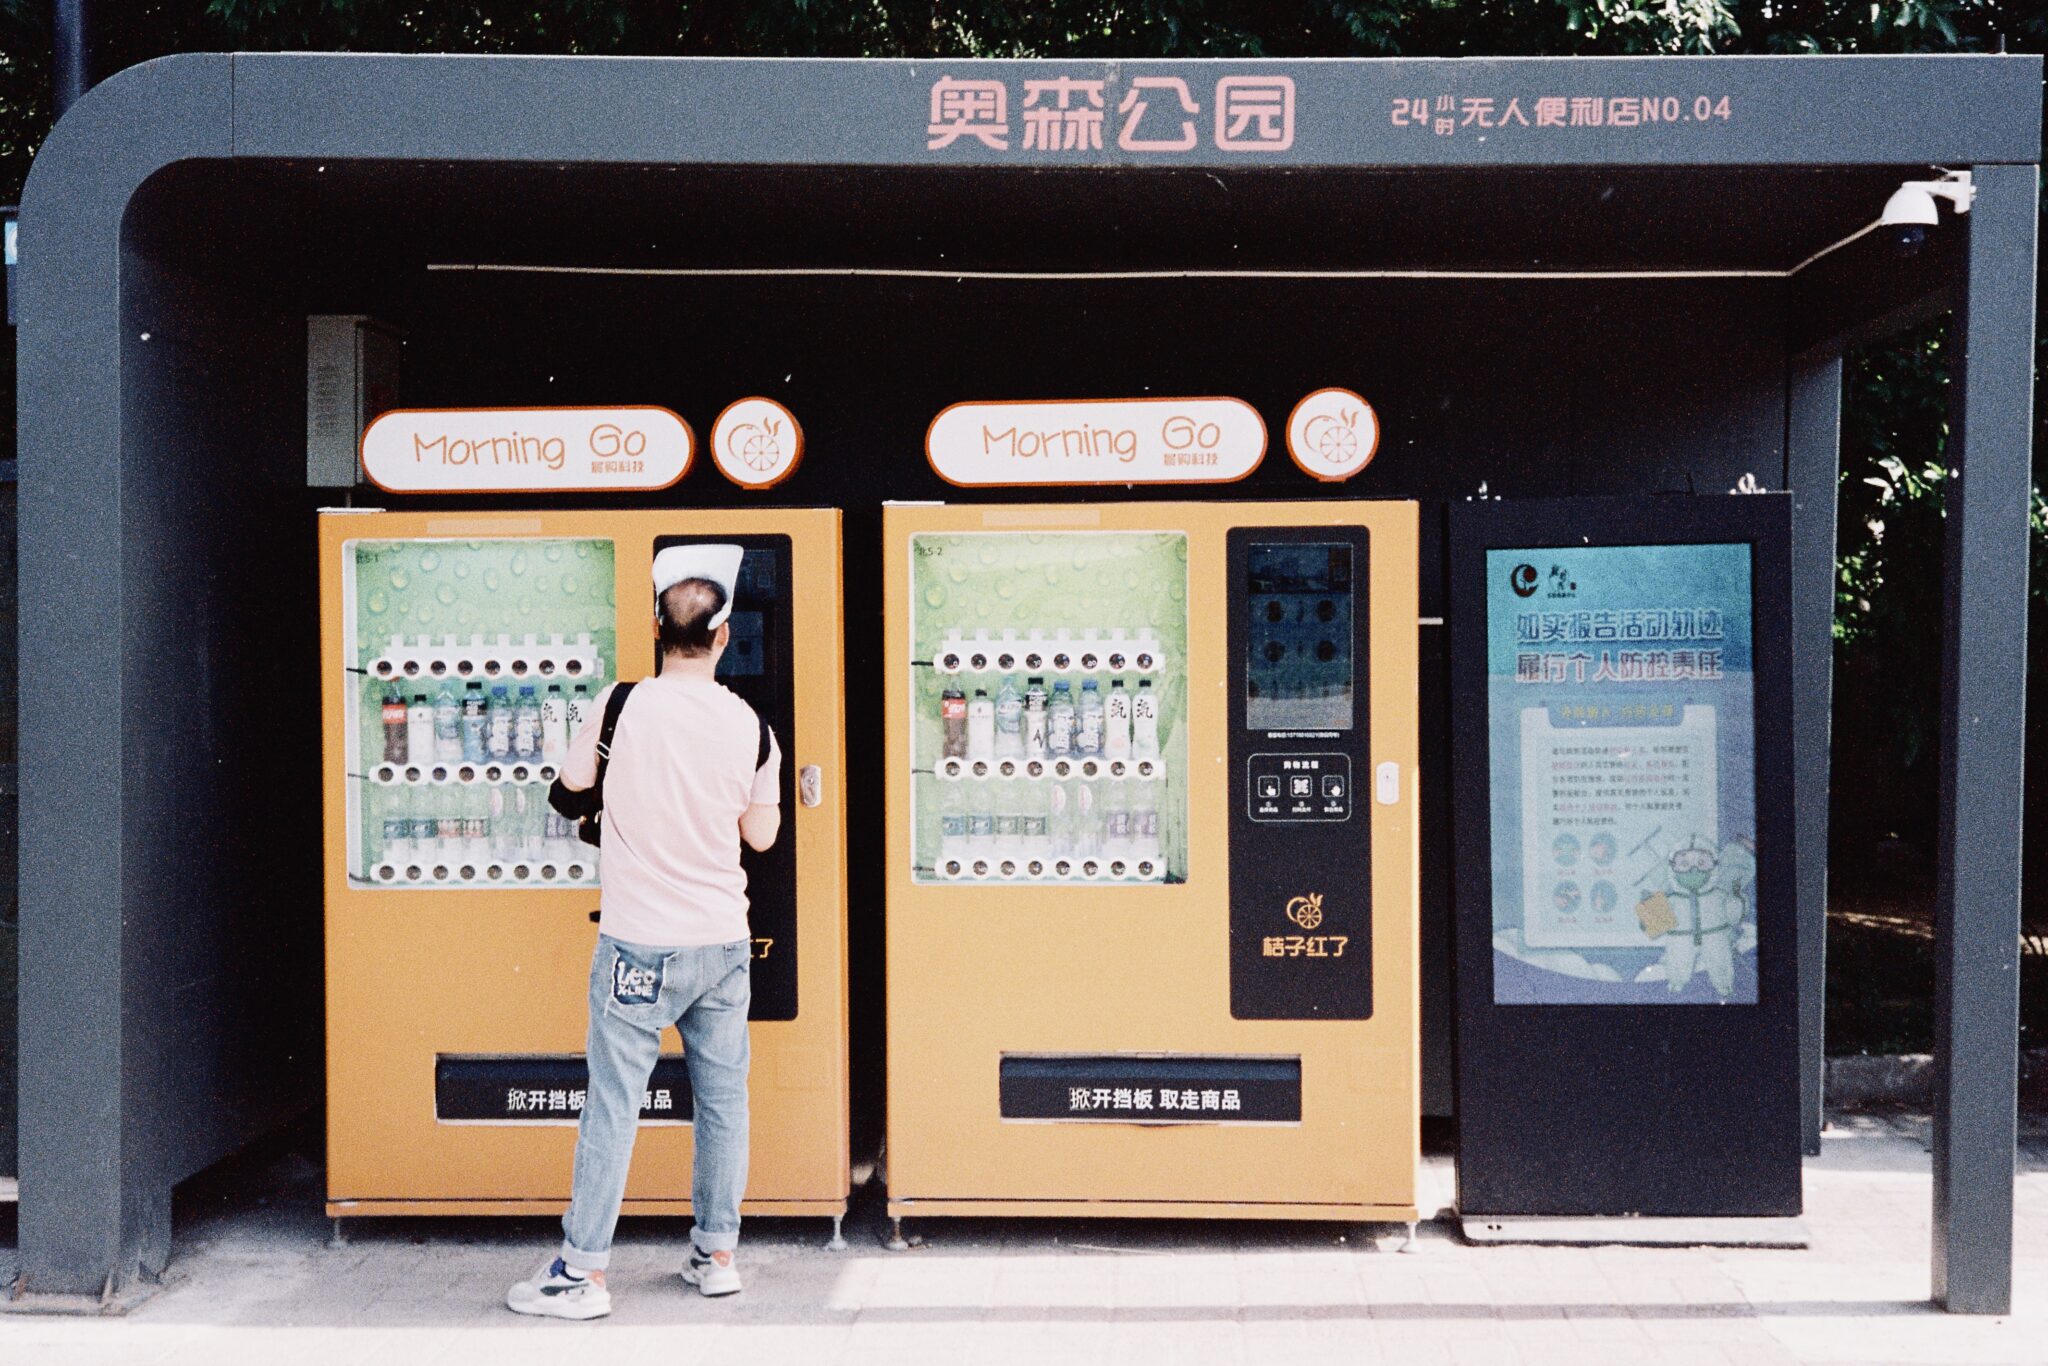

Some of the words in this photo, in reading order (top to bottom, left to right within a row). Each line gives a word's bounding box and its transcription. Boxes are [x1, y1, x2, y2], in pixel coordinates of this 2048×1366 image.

[927, 75, 1297, 151] 奥森公园
[412, 431, 566, 470] Morning
[589, 423, 647, 457] Go
[982, 424, 1138, 463] Morning
[1161, 415, 1221, 449] Go
[1515, 650, 1724, 684] 履行个人防控责任
[1262, 935, 1349, 957] 桔子红了
[1069, 1088, 1153, 1110] 掀开挡板
[1159, 1089, 1241, 1110] 取走商品
